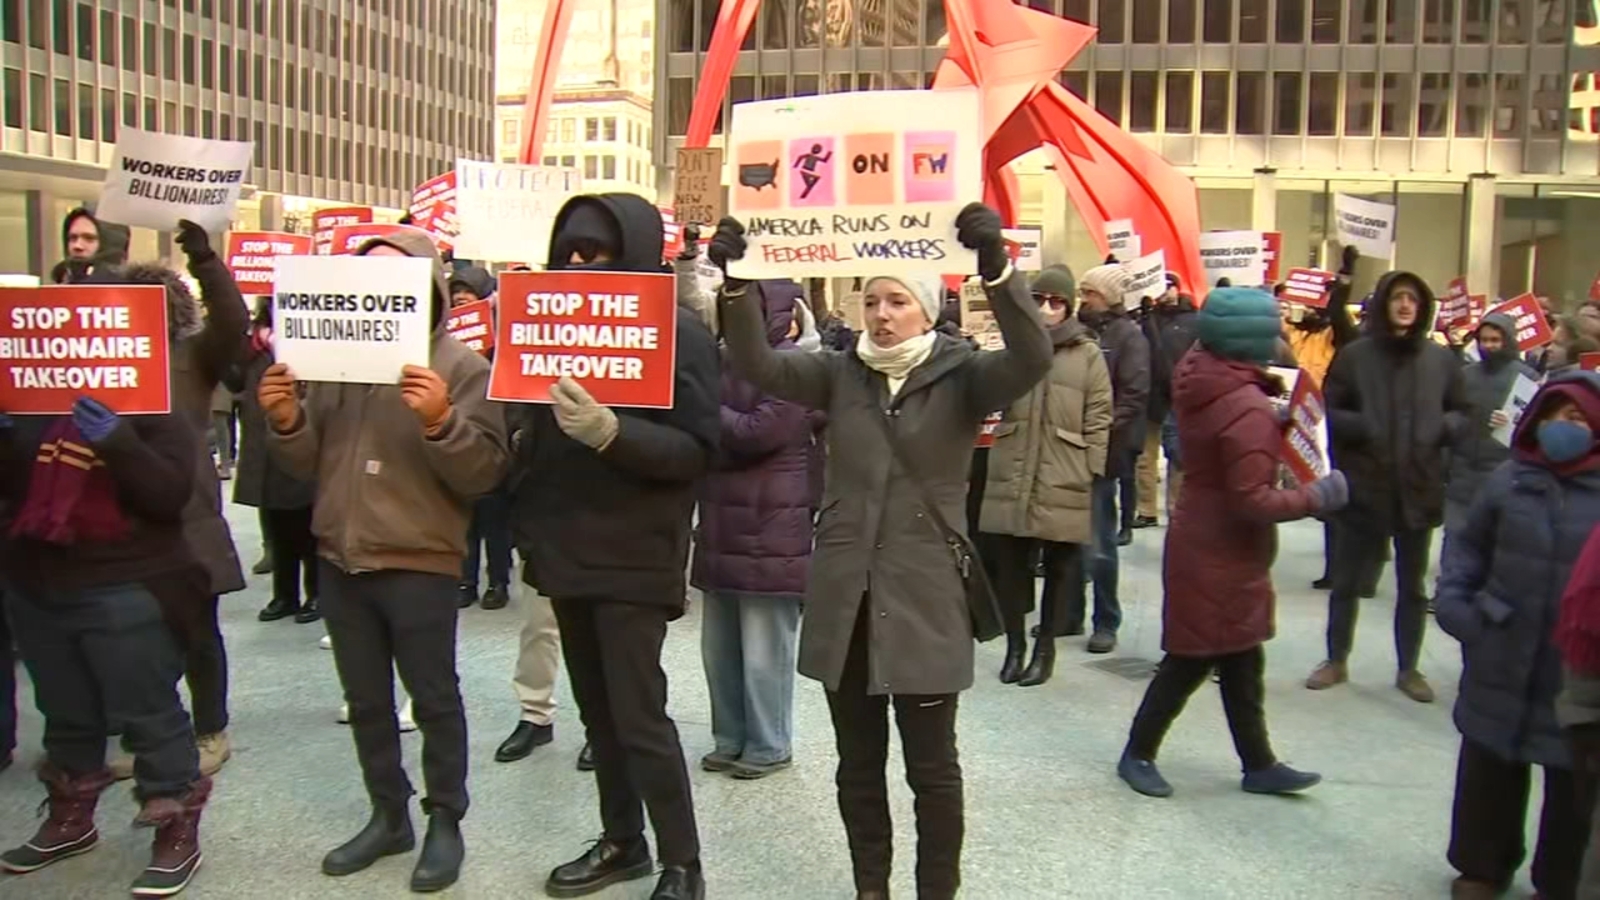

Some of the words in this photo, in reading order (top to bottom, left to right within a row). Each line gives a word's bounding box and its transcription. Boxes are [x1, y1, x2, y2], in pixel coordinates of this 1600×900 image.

[122, 157, 206, 183] WORKERS
[208, 169, 242, 184] OVER
[852, 153, 889, 174] ON
[913, 153, 948, 174] FW
[128, 178, 229, 205] BILLIONAIRES!
[748, 216, 823, 237] AMERICA
[832, 214, 890, 234] RUNS
[899, 212, 931, 229] ON
[241, 241, 270, 254] STOP
[271, 242, 295, 255] THE
[761, 243, 853, 262] FEDERAL
[853, 239, 946, 260] WORKERS
[277, 292, 358, 312] WORKERS
[361, 294, 417, 313] OVER
[526, 292, 584, 316] STOP
[588, 293, 639, 318] THE
[11, 306, 71, 330] STOP
[76, 306, 130, 330] THE
[284, 316, 400, 342] BILLIONAIRES!
[510, 322, 658, 349] BILLIONAIRE
[0, 336, 152, 360] BILLIONAIRE
[10, 366, 139, 389] TAKEOVER
[519, 353, 643, 380] TAKEOVER
